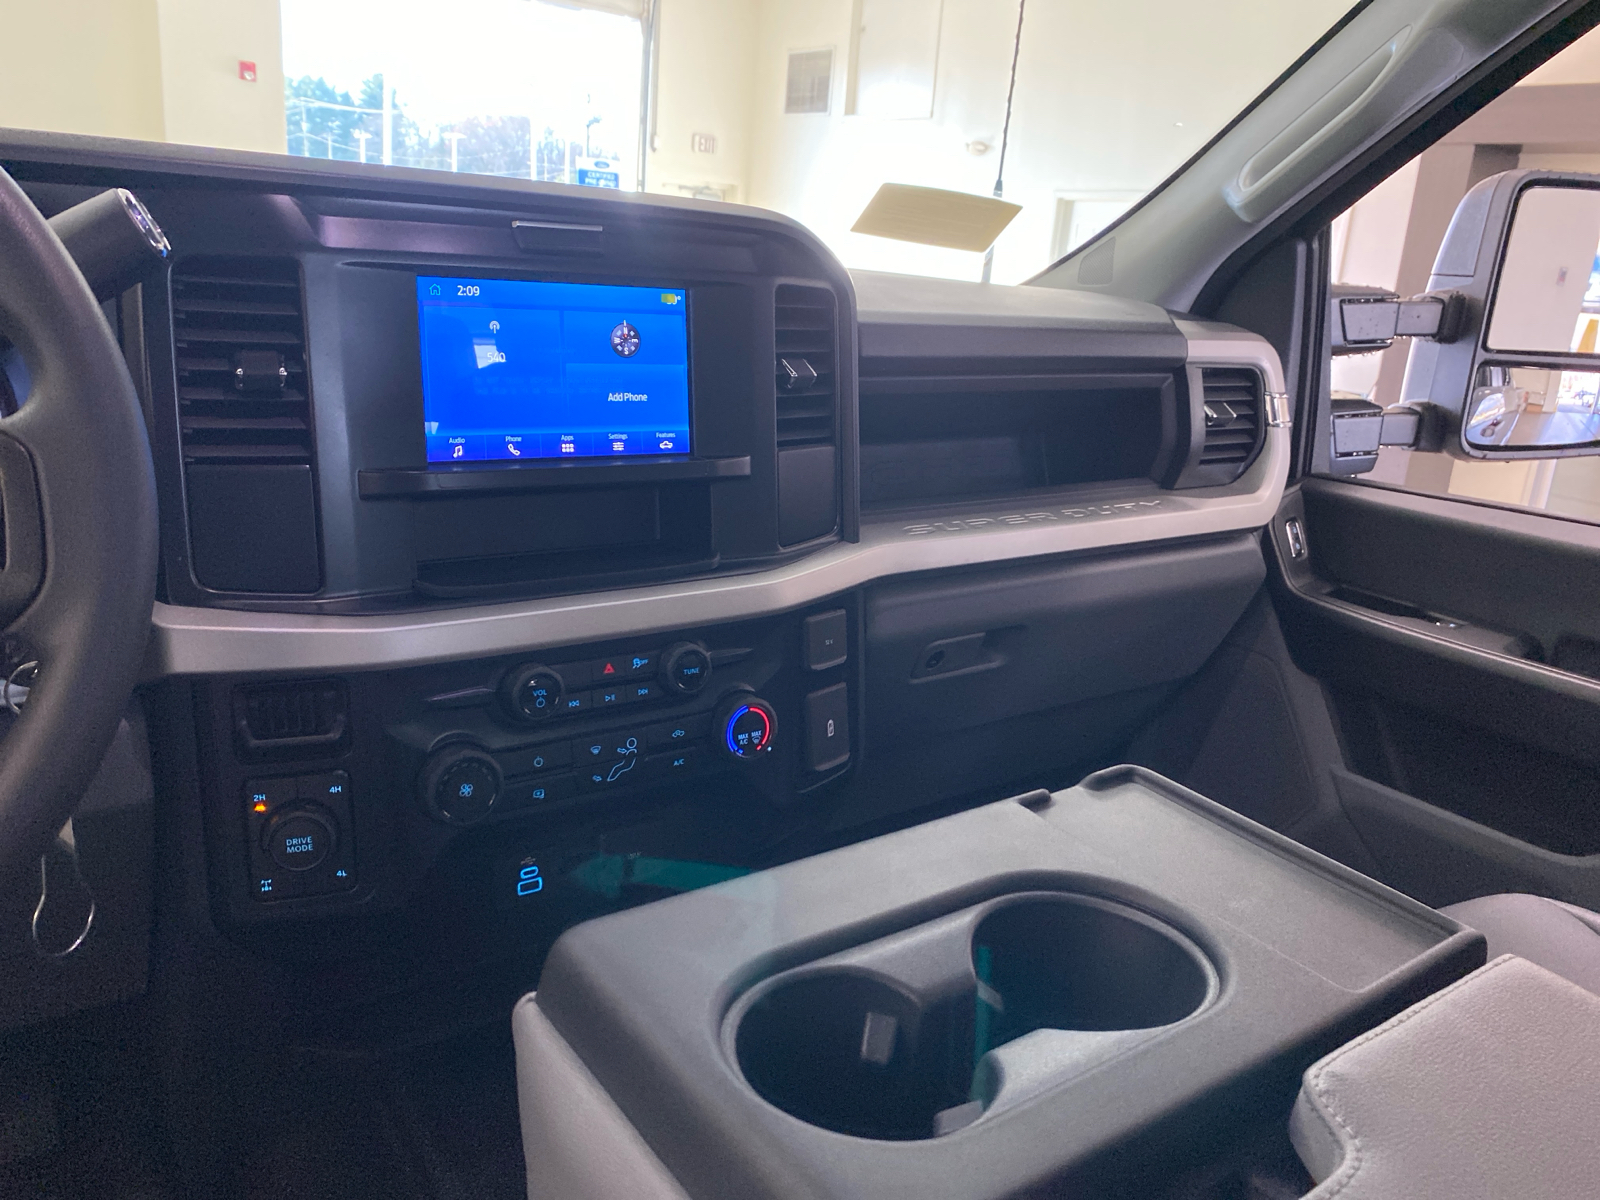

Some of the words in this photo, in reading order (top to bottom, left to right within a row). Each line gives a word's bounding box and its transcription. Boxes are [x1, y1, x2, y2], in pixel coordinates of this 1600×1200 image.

[698, 134, 715, 154] EXIT
[587, 171, 616, 180] CERTIFIED
[457, 285, 480, 296] 2:09
[486, 352, 506, 363] 540
[607, 392, 623, 402] Add
[624, 392, 648, 402] Phone
[607, 433, 628, 441] Settings
[655, 431, 676, 439] Features
[902, 511, 1058, 535] SUPER
[1060, 499, 1162, 519] DUTY
[683, 667, 700, 676] TUNE
[532, 689, 547, 697] VOL
[329, 785, 342, 793] 4H
[253, 794, 266, 802] 2H
[286, 836, 313, 846] DRIVE
[286, 843, 314, 853] MODE
